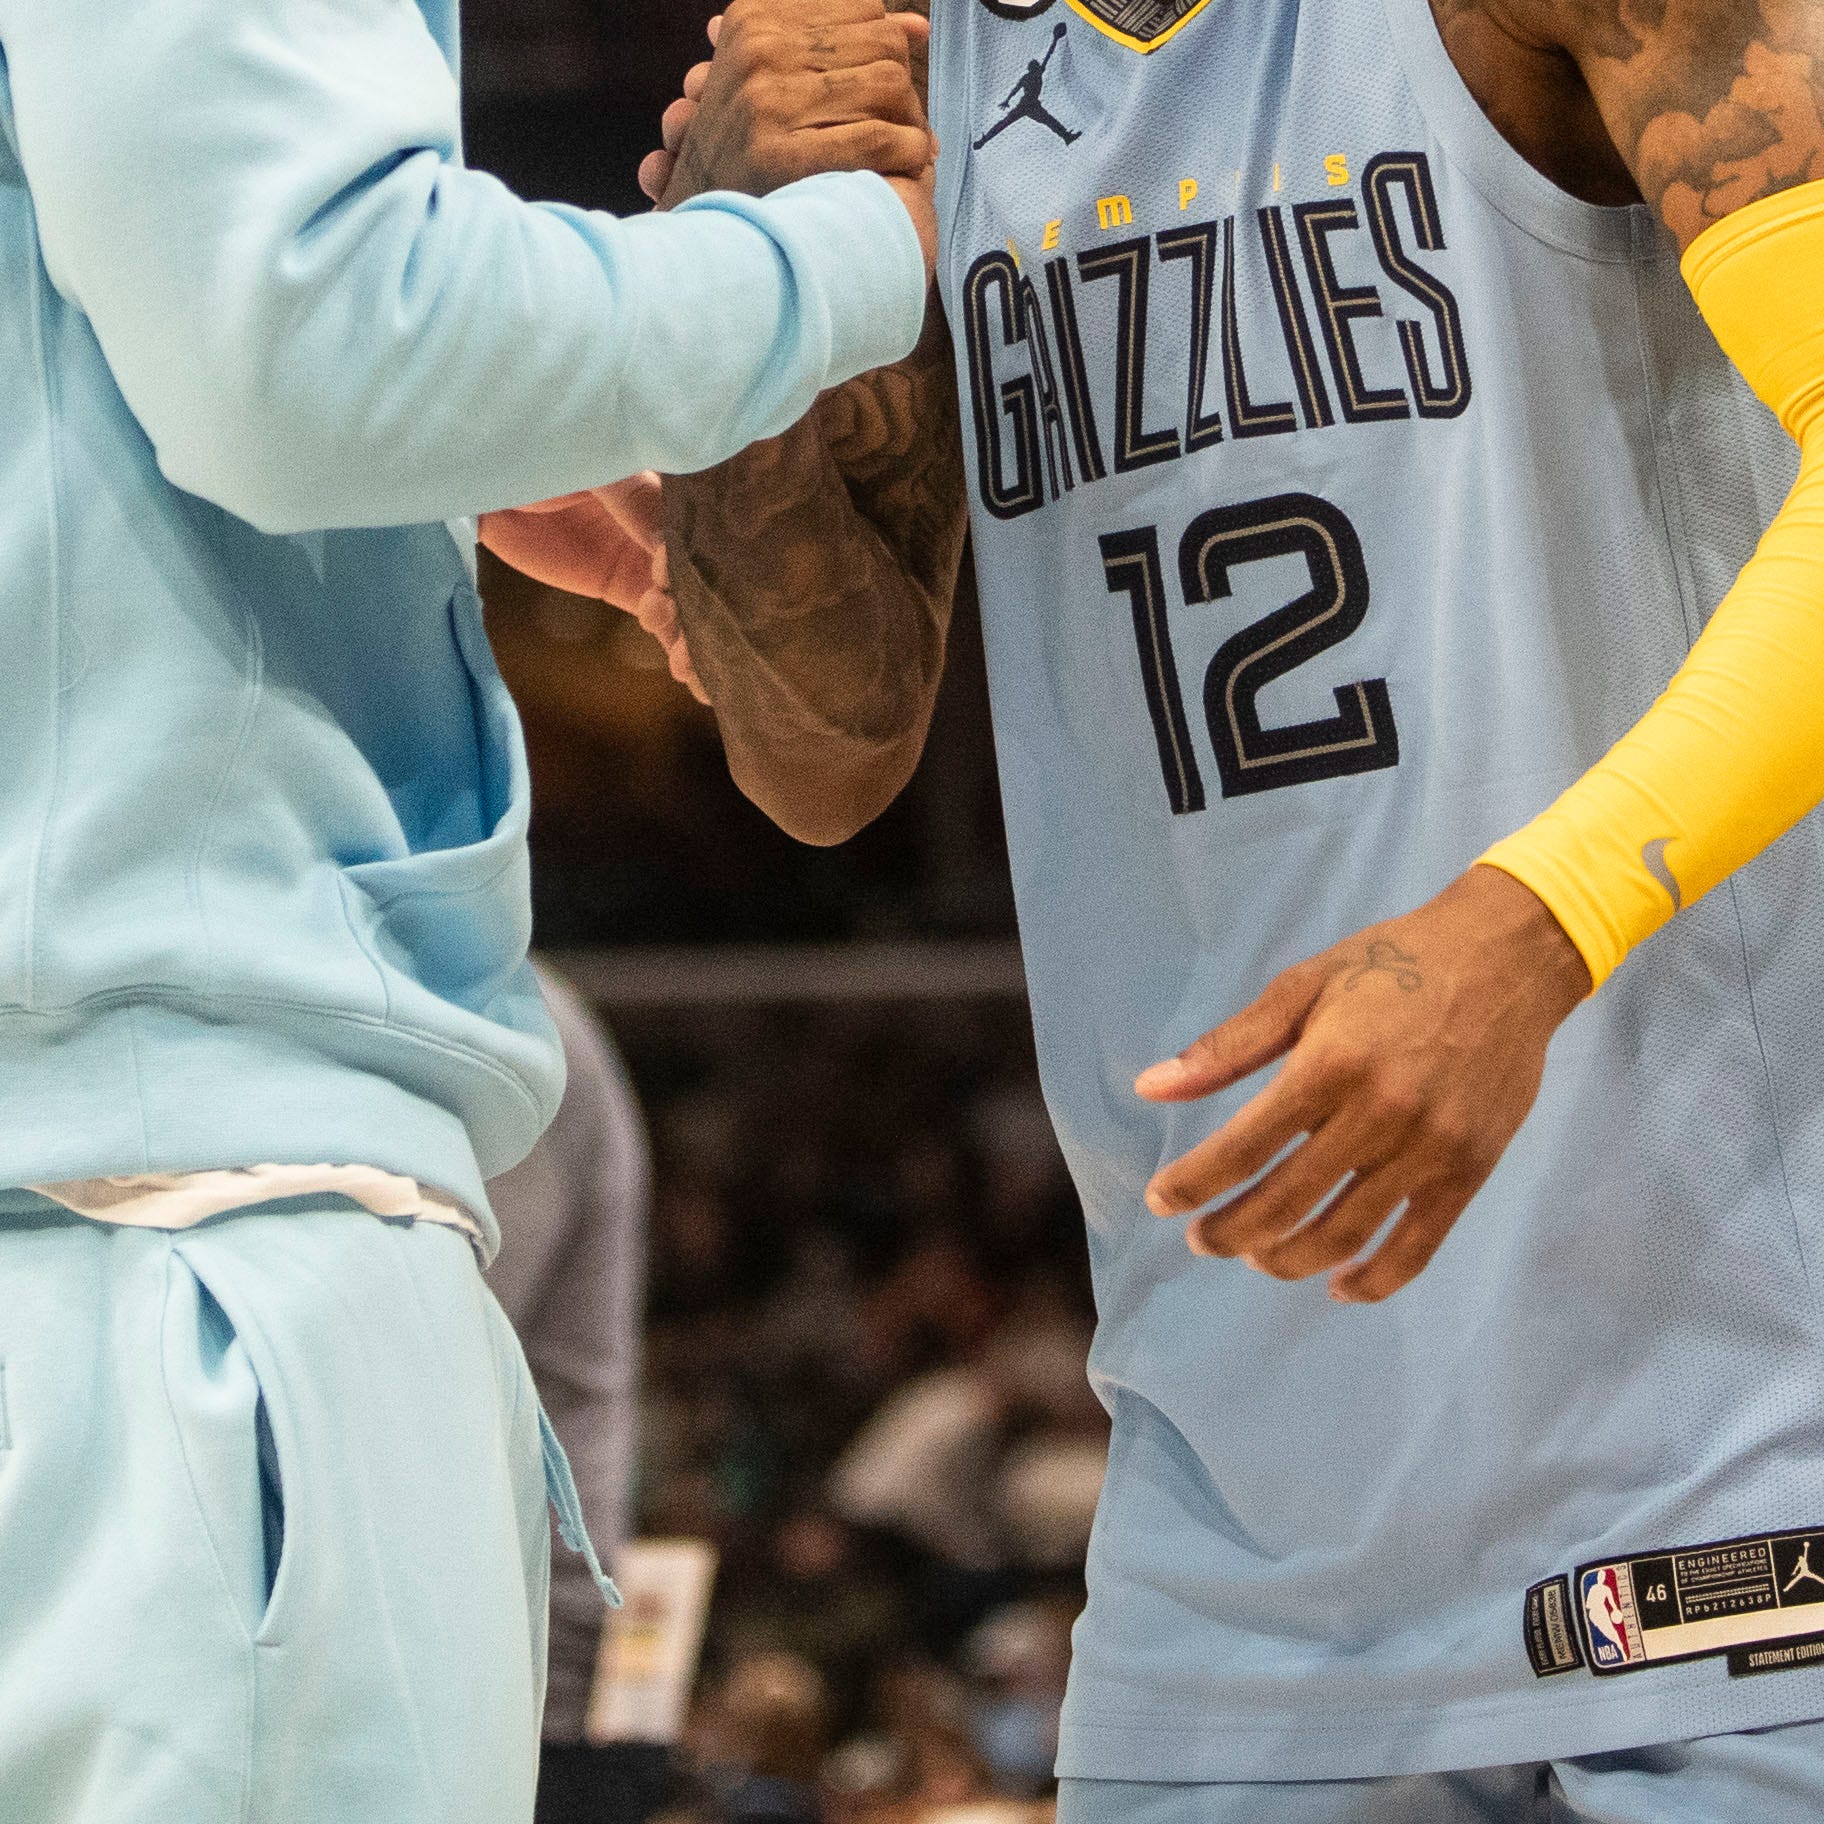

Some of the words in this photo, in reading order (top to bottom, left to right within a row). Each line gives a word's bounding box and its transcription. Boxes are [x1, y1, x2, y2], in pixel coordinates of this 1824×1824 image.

[963, 151, 1473, 521] GRIZZLIES
[1098, 492, 1400, 815] 12
[1678, 1547, 1766, 1570] ENGINEERED
[1646, 1583, 1667, 1603] 46
[1597, 1644, 1618, 1662] NBA
[1748, 1648, 1794, 1667] STATEMENT
